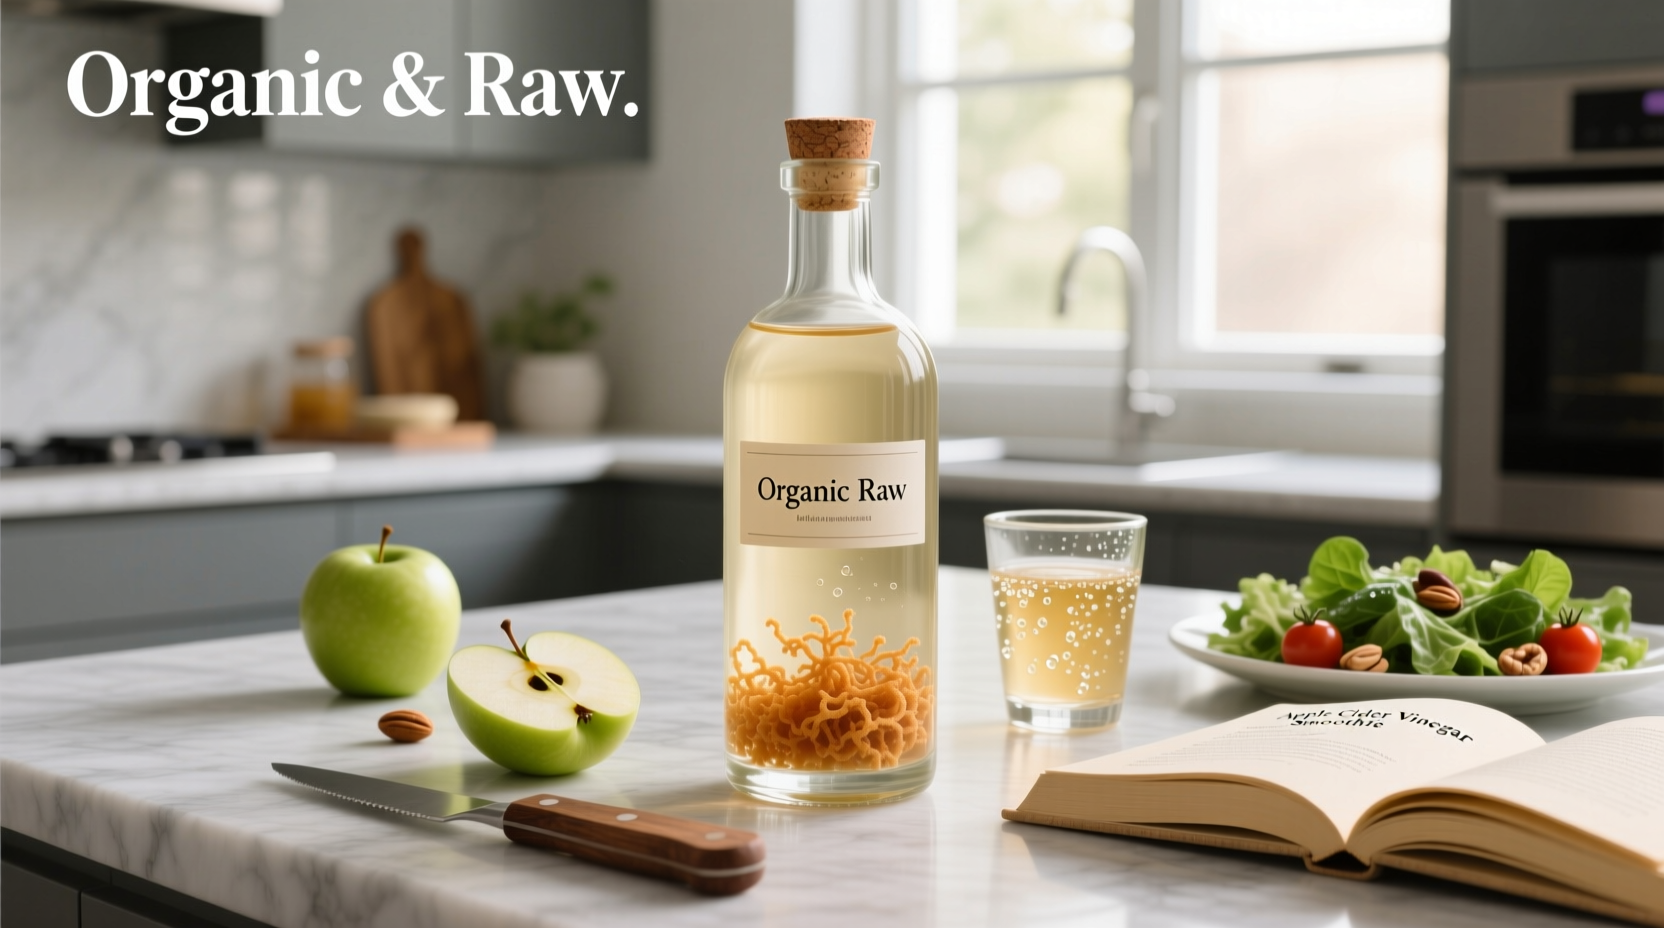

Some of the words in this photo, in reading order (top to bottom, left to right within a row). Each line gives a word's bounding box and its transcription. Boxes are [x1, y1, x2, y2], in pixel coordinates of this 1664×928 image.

[757, 476, 850, 510] Organic
[858, 478, 907, 502] Raw
[1399, 711, 1473, 742] Vinegar
